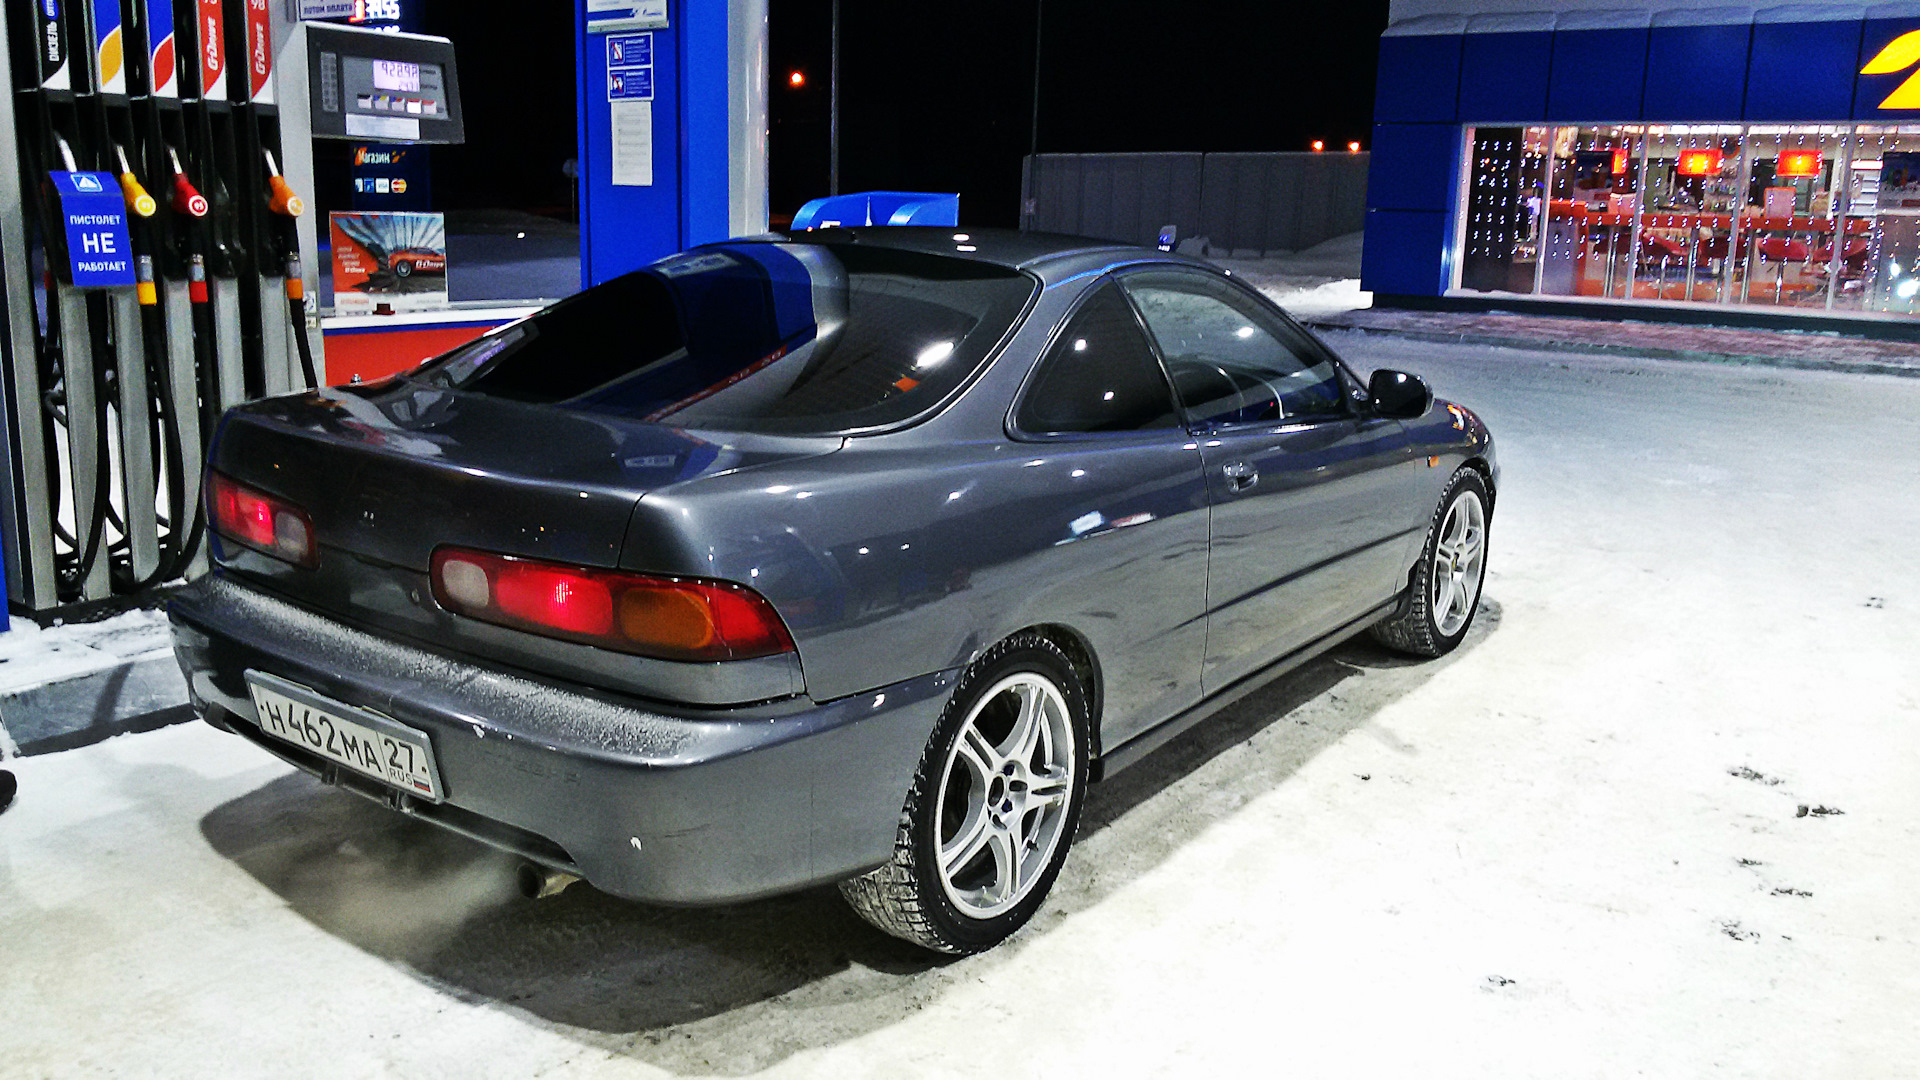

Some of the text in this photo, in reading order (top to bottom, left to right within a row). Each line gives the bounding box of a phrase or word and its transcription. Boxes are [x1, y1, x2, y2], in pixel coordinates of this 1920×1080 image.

[69, 214, 121, 225] ПИСТОЛЕТ
[82, 232, 116, 254] НЕ
[78, 261, 126, 272] РАБОТАЕТ
[384, 738, 414, 773] 27
[389, 767, 414, 786] RUS
